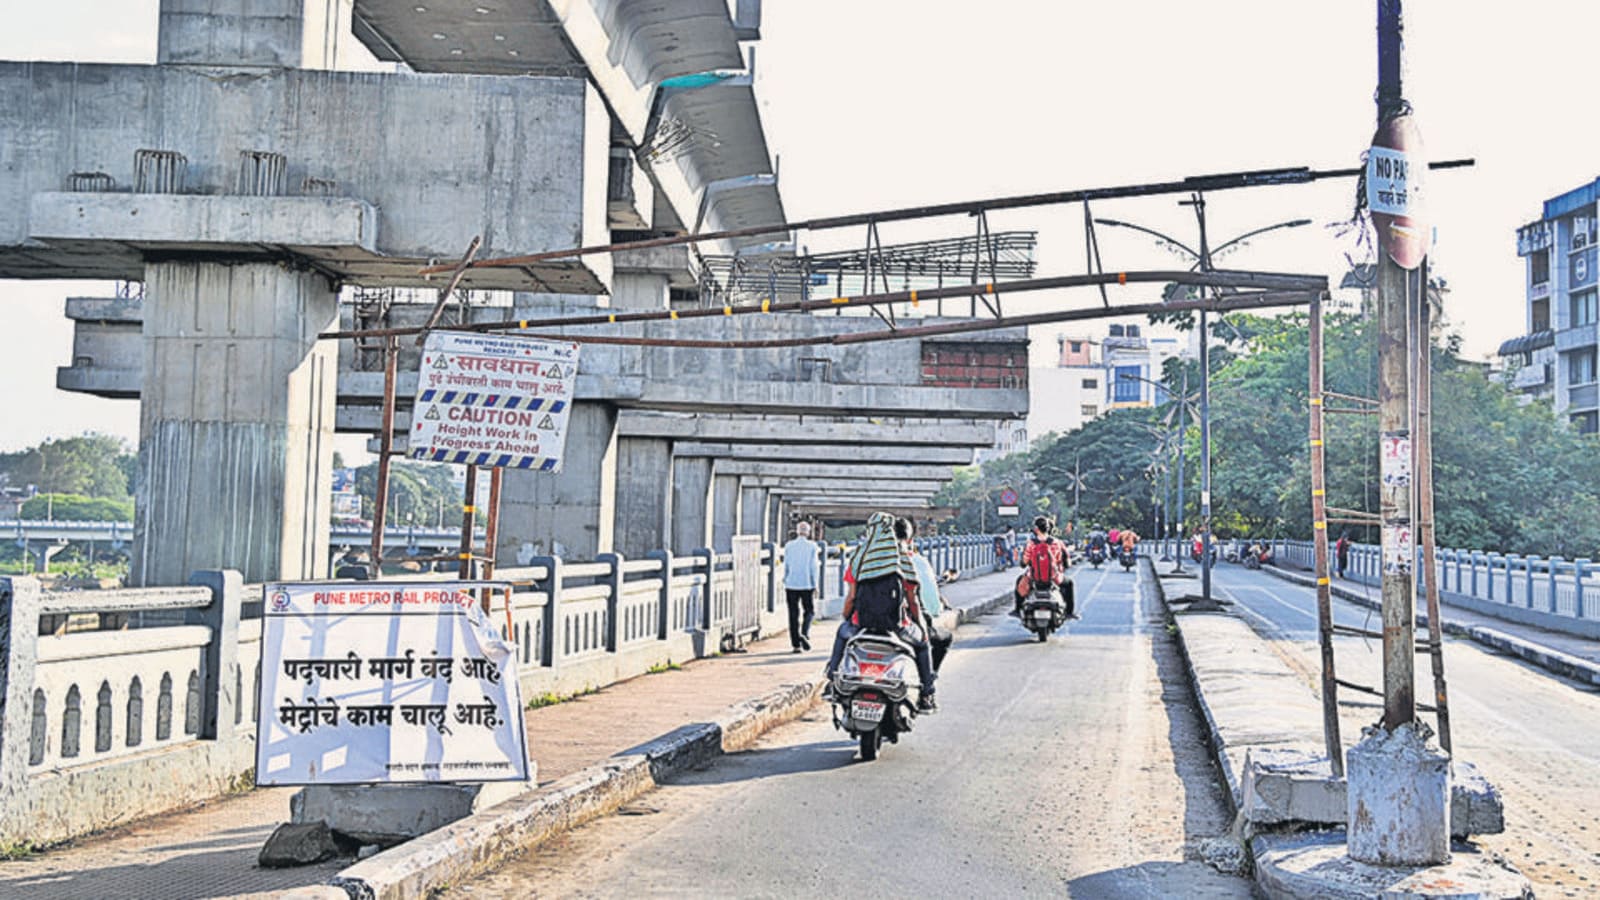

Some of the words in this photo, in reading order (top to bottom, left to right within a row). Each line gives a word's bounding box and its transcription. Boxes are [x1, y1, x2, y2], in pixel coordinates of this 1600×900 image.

[1376, 156, 1391, 178] NO
[516, 342, 549, 351] PROJECT
[491, 378, 512, 389] काम
[448, 406, 532, 427] CAUTION
[438, 423, 481, 438] Height
[485, 426, 520, 440] Work
[432, 435, 491, 449] Progress
[495, 441, 539, 454] Ahead
[314, 592, 346, 605] PUNE
[350, 592, 390, 605] METRO
[394, 591, 420, 604] RAIL
[283, 652, 362, 685] पदचारी
[368, 649, 415, 679] मार्ग
[280, 697, 340, 734] मेट्रोचे
[347, 704, 393, 727] काम
[401, 704, 453, 735] चालू
[454, 696, 504, 730] आहे.
